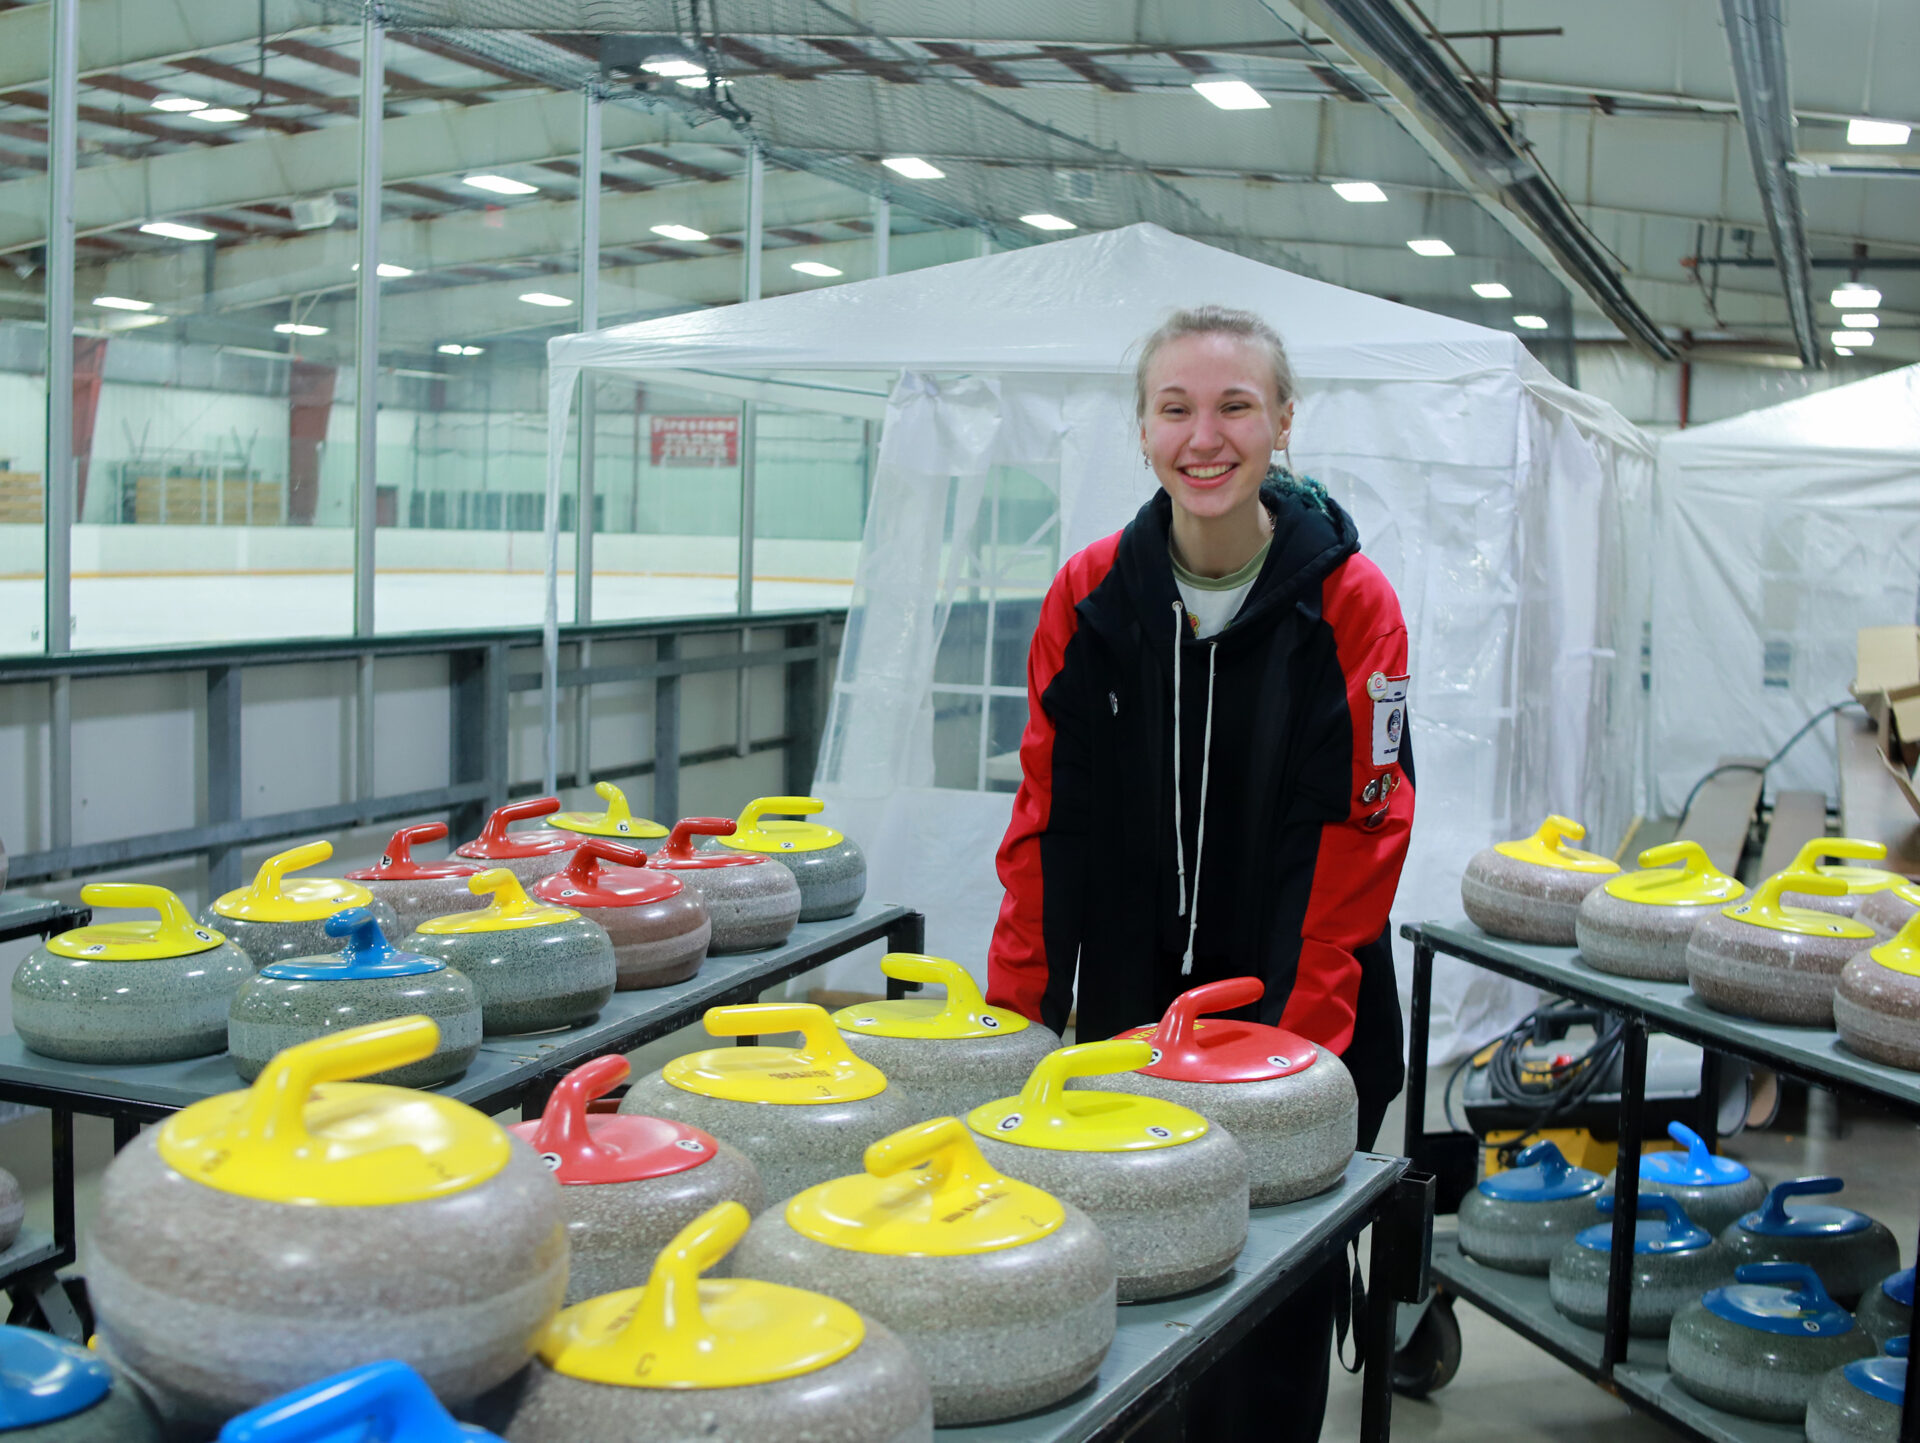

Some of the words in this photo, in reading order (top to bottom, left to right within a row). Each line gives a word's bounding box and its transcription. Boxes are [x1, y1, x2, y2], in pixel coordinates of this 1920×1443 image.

[982, 1016, 998, 1028] C
[1001, 1116, 1020, 1129] C
[1151, 1127, 1169, 1137] 5
[634, 1351, 656, 1378] C
